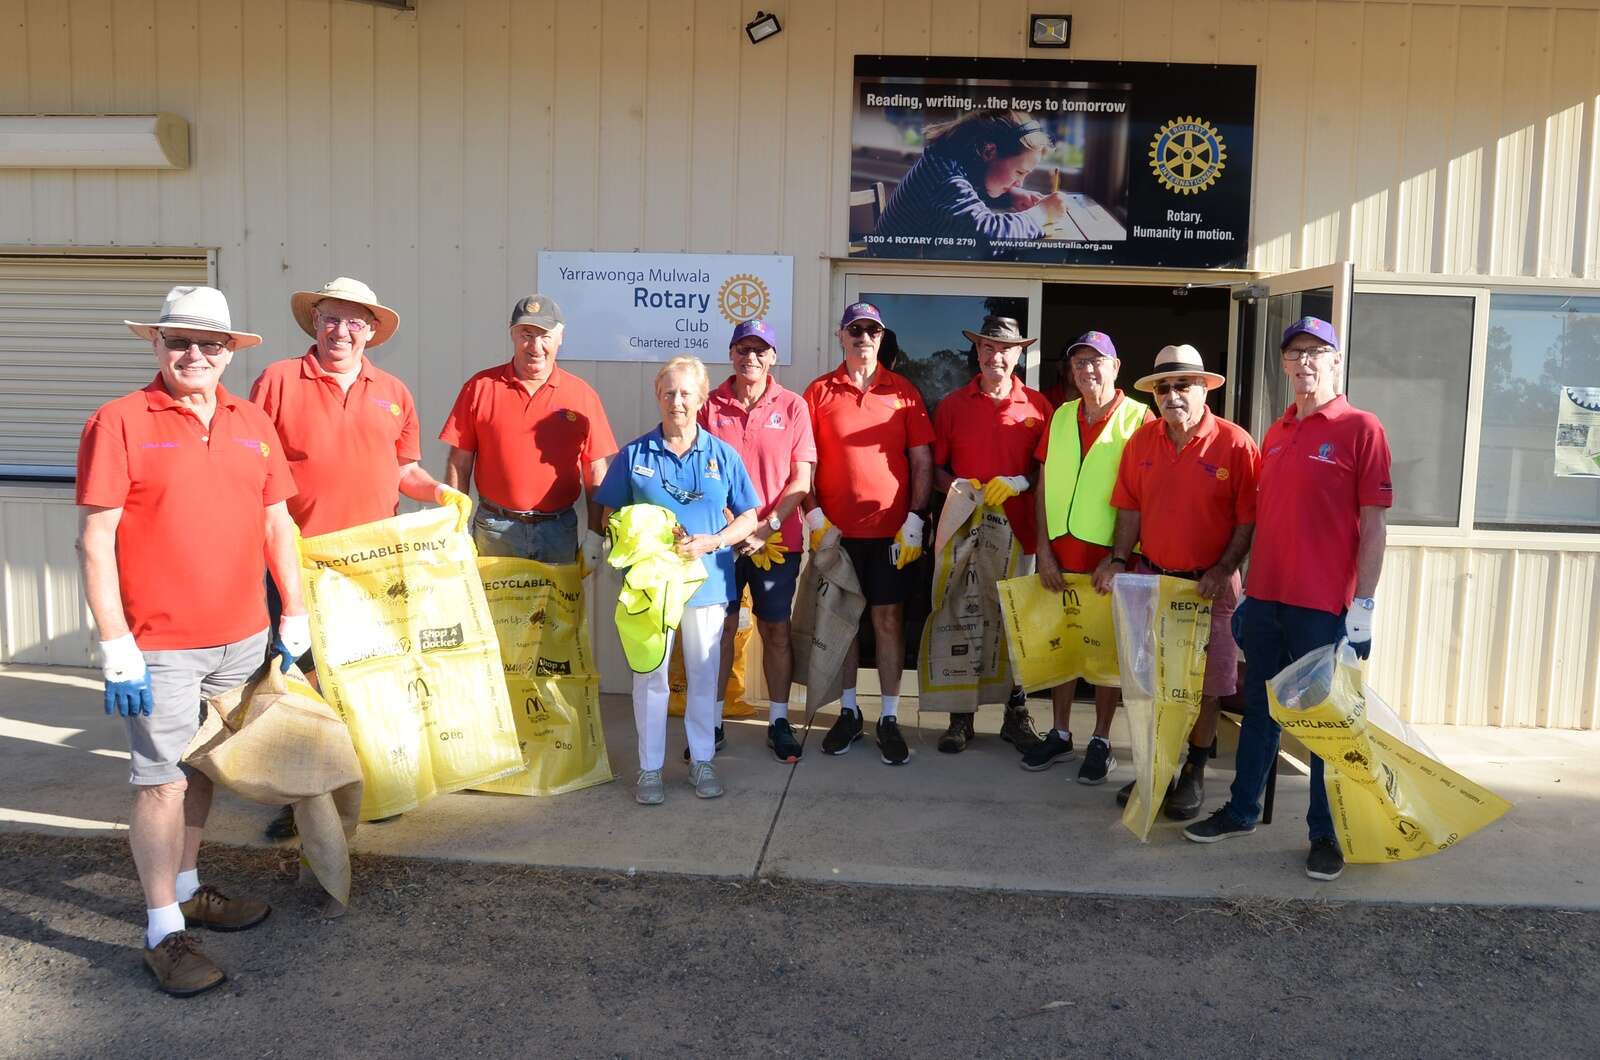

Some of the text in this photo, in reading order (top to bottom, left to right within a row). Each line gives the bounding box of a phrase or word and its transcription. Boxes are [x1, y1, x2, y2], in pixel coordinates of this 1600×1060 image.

[866, 93, 922, 109] Reading,
[1011, 97, 1042, 112] keys
[1045, 98, 1059, 111] to
[1062, 98, 1126, 113] tomorrow
[1172, 124, 1206, 134] ROTARY
[1167, 209, 1203, 225] Rotary.
[1133, 225, 1235, 241] Humanity in motion.
[863, 235, 977, 247] 1300 4 ROTARY (768 279)
[989, 239, 1113, 252] www.rotaryaustralia.org.au
[559, 266, 711, 284] Yarrawonga Mulwala
[633, 287, 711, 314] Rotary
[675, 318, 710, 333] Club
[629, 336, 709, 350] Chartered 1946
[986, 513, 1008, 526] ONLY
[315, 543, 410, 570] RECYCLABLES
[413, 538, 447, 552] ONLY
[423, 638, 457, 649] Docket
